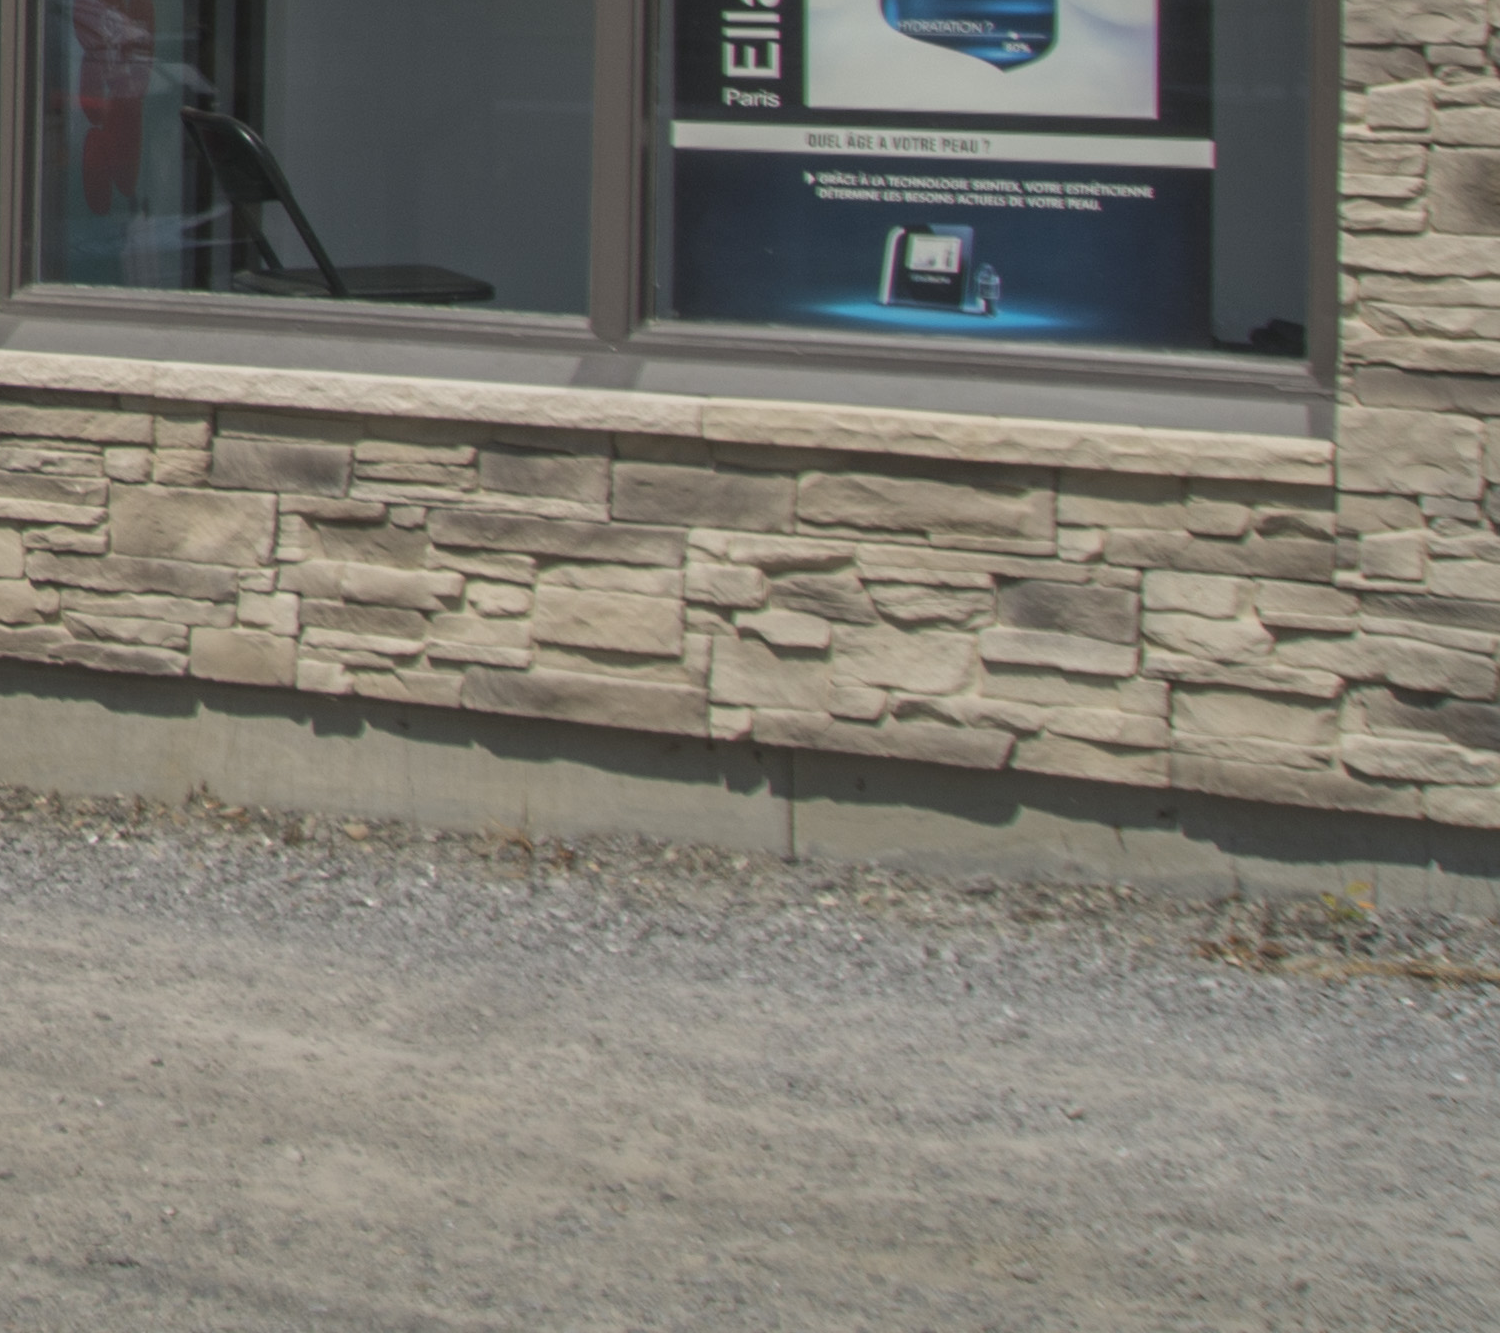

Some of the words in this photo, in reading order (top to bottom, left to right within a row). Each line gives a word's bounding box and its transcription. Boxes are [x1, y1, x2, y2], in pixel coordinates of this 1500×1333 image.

[898, 19, 983, 33] HYDRATATION
[722, 87, 781, 108] Paris
[808, 133, 842, 148] QUEL
[847, 132, 873, 150] ÂGE
[879, 137, 888, 150] A
[893, 137, 936, 152] VOTRE
[942, 138, 979, 154] PEAU
[983, 139, 991, 154] ?
[1024, 180, 1063, 195] VOTRE
[1026, 196, 1065, 210] VOTRE
